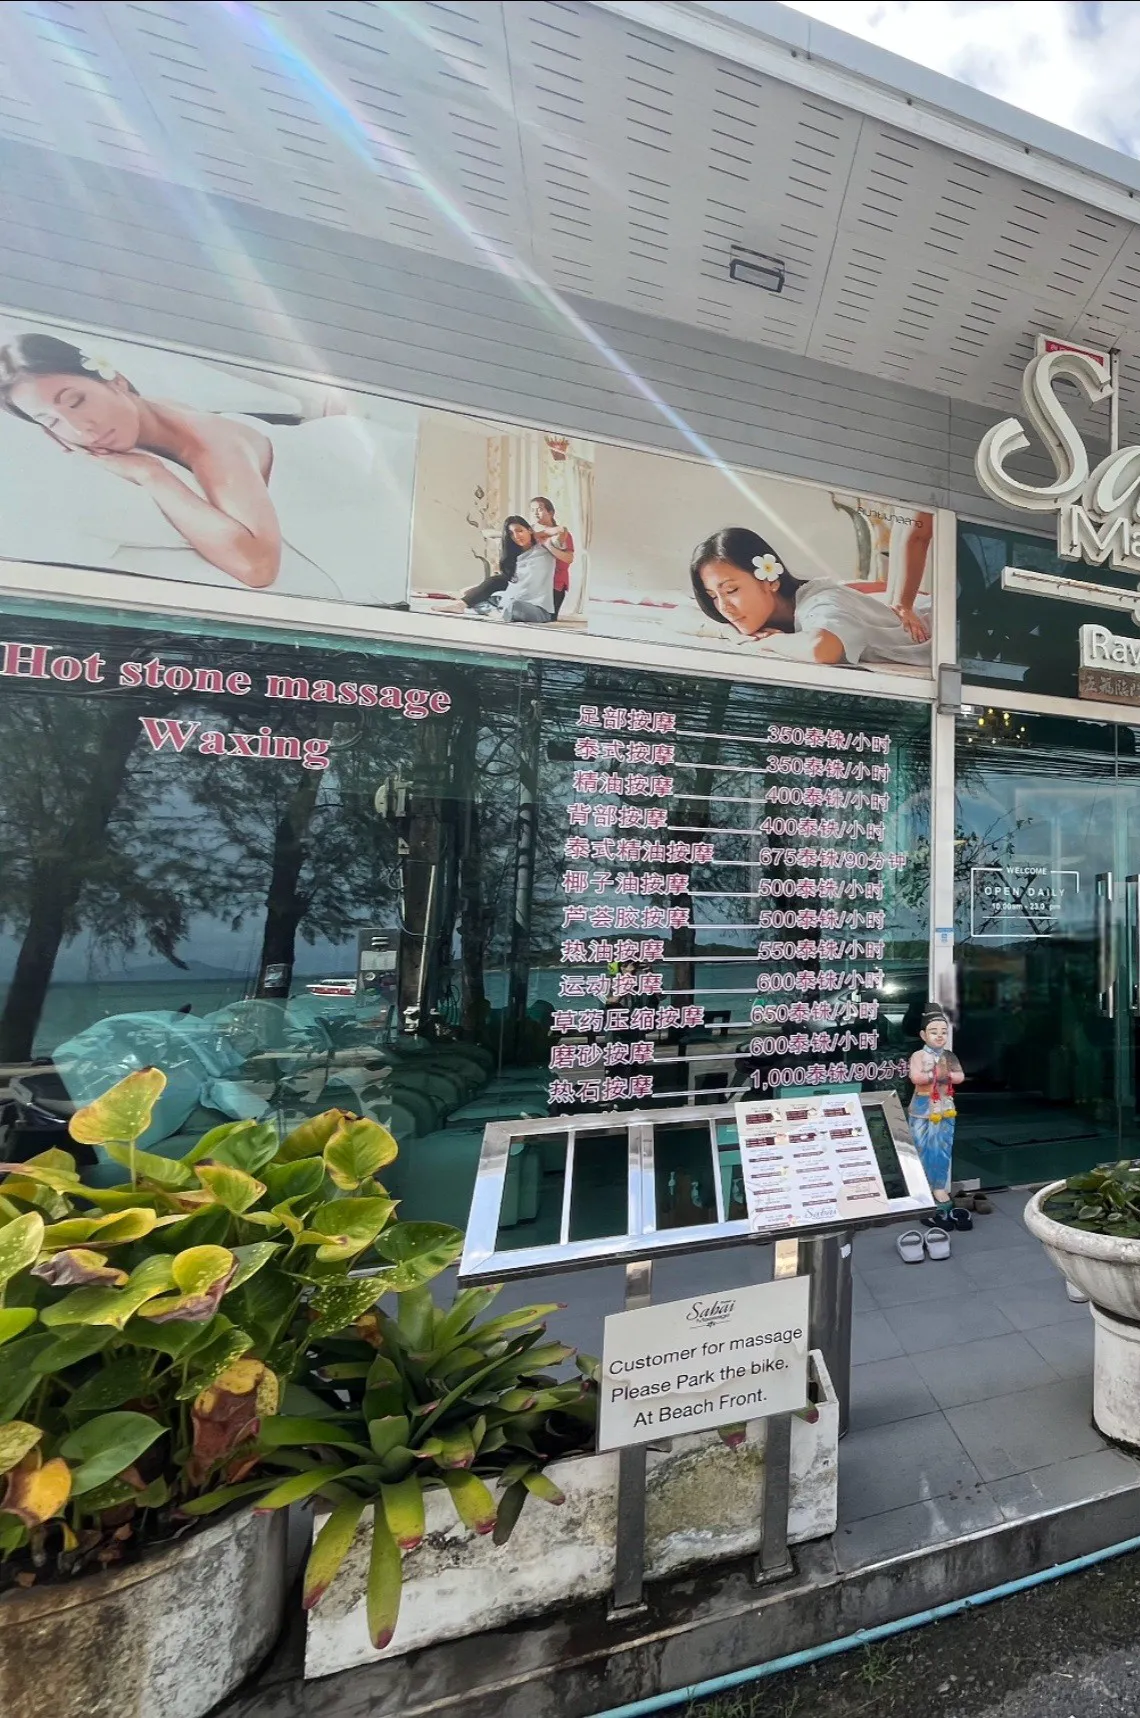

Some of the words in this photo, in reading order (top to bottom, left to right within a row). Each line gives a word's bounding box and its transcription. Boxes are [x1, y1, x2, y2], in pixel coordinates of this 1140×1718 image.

[0, 642, 106, 683] Hot
[118, 657, 252, 695] stone
[264, 671, 452, 719] massage
[139, 716, 331, 770] Waxing
[576, 705, 676, 734] 足部按摩
[767, 725, 891, 755] 350泰铢/小时
[574, 738, 675, 767] 泰式按摩
[766, 756, 891, 785] 350泰铢/小时
[572, 770, 674, 799] 精油按摩
[765, 786, 890, 813] 400泰铢/小时
[566, 804, 668, 830] 背部按摩
[759, 817, 886, 842] 400泰铢/小时
[564, 837, 714, 864] 泰式精油按摩
[759, 847, 907, 872] 675泰铢/90分钟
[1006, 867, 1048, 875] WELCOME
[562, 870, 690, 896] 椰子油按摩
[758, 878, 885, 900] 500泰铢/小时
[984, 886, 1020, 897] OPEN
[1027, 887, 1065, 897] DAILY
[562, 906, 691, 930] 芦荟胶按摩
[758, 909, 885, 931] 500泰铢/小时
[560, 939, 665, 963] 热油按摩
[757, 938, 885, 961] 550泰铢/小时
[558, 973, 664, 999] 运动按摩
[756, 969, 885, 993] 600泰铢/小时
[550, 1006, 705, 1034] 草药压缩按摩
[750, 999, 880, 1025] 650泰铢/小时
[548, 1041, 655, 1069] 磨砂按摩
[750, 1029, 880, 1058] 600泰铢/小时
[548, 1075, 654, 1104] 热石按摩
[686, 1300, 736, 1321] Sabai
[609, 1344, 698, 1375] Customer
[701, 1339, 724, 1357] for
[729, 1327, 803, 1355] massage
[611, 1377, 671, 1402] Please
[676, 1370, 716, 1390] Park
[719, 1362, 746, 1382] the
[750, 1355, 789, 1375] bike.
[633, 1410, 654, 1427] At
[659, 1401, 714, 1422] Beach
[719, 1388, 767, 1410] Front.
